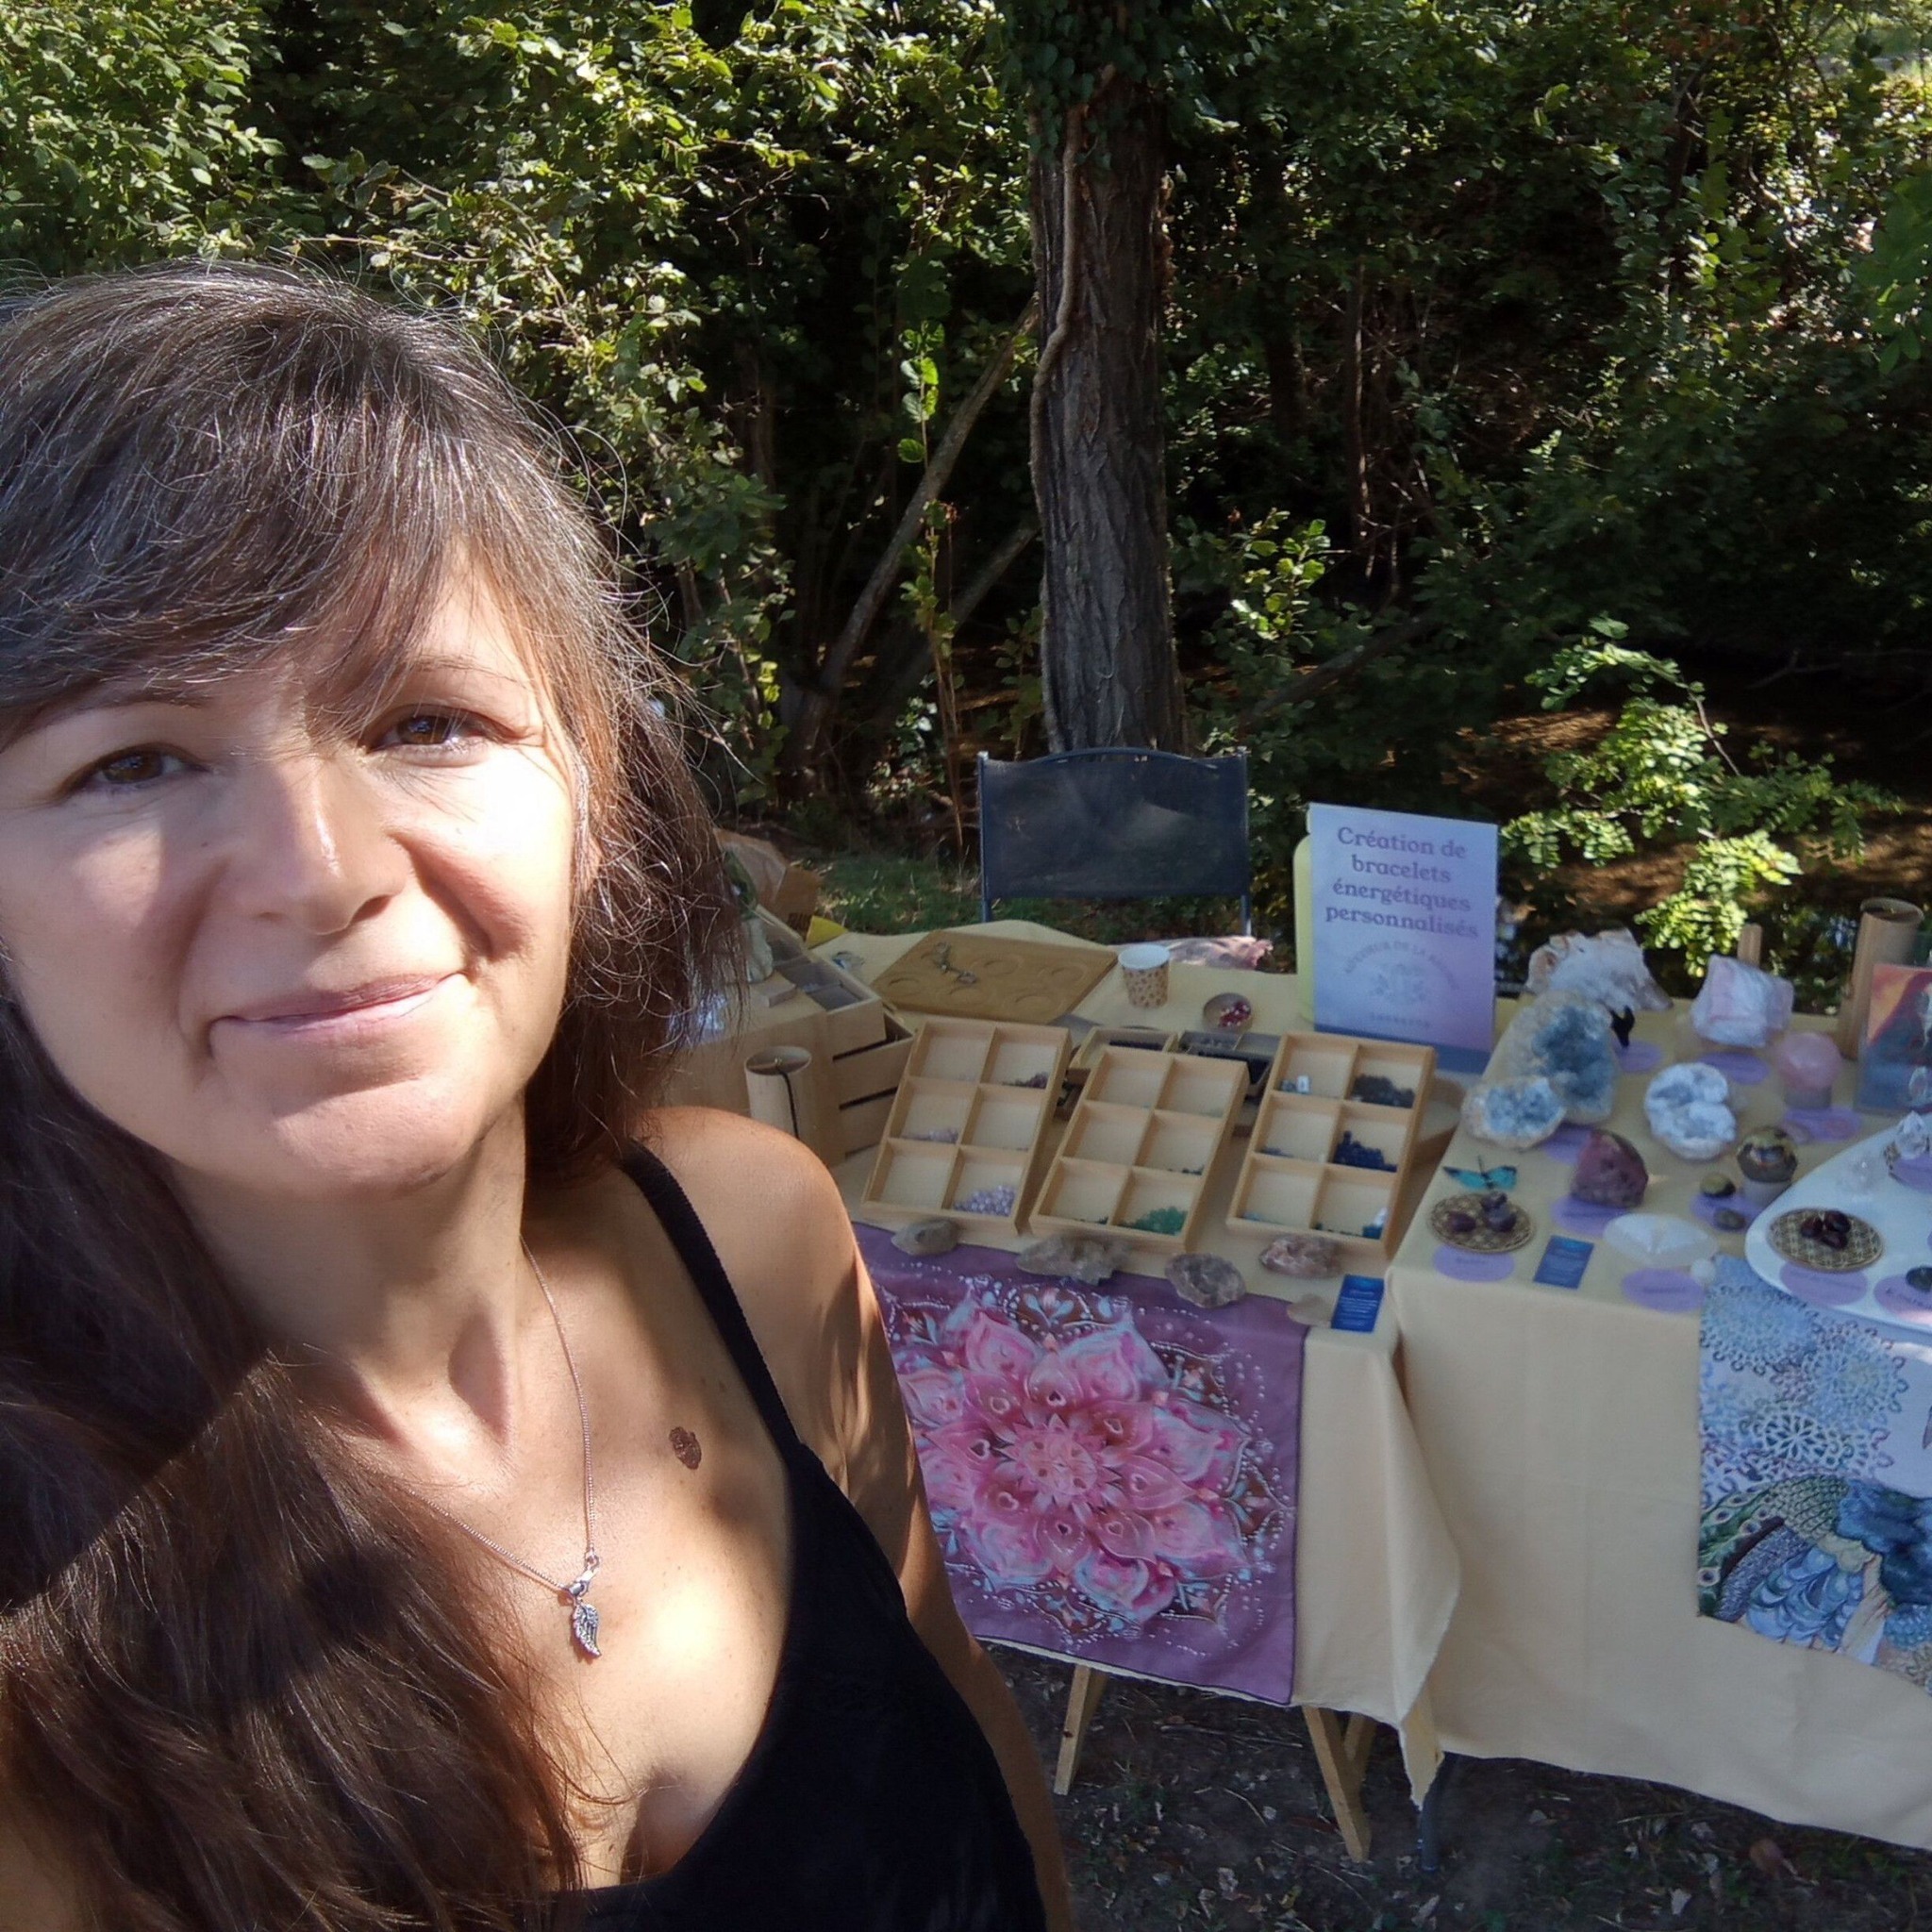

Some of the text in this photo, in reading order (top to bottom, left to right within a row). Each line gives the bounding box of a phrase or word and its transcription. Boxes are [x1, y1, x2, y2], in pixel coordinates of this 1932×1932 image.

[1338, 826, 1468, 858] Création de
[1352, 854, 1452, 883] bracelets
[1333, 877, 1472, 912] énergétiques
[1325, 906, 1479, 939] personnalisés
